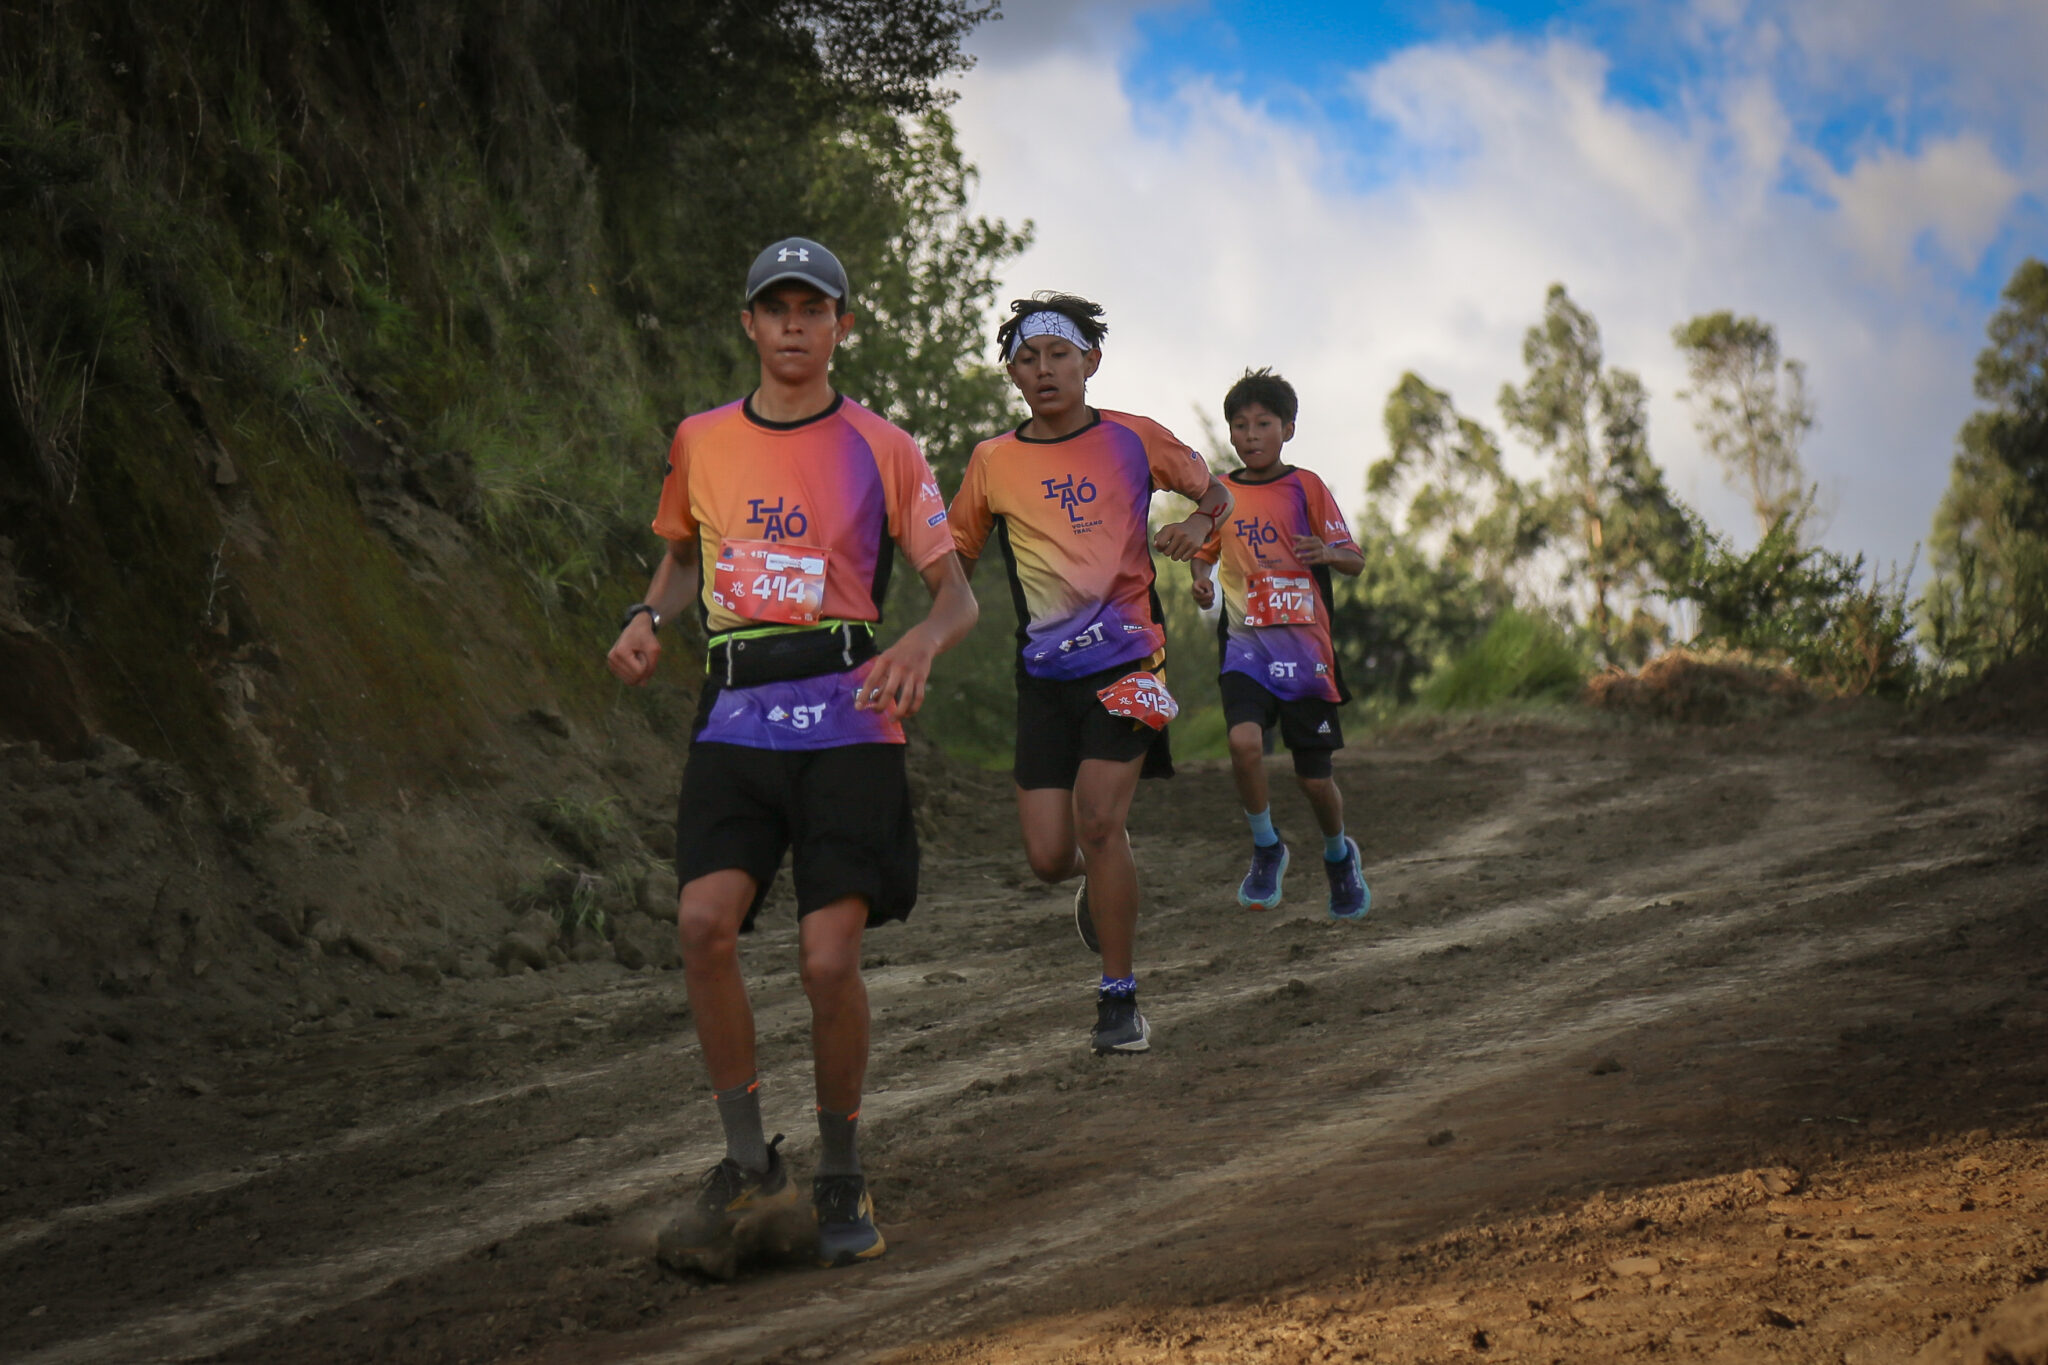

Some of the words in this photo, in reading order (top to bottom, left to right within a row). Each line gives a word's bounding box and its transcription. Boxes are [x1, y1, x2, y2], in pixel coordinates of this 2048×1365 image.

[1071, 519, 1103, 530] VOLCANO
[1073, 528, 1093, 536] TRAIL
[751, 573, 807, 604] 414
[1268, 591, 1303, 611] 417
[1075, 621, 1104, 648] ST
[1273, 661, 1298, 678] ST
[792, 702, 826, 729] ST
